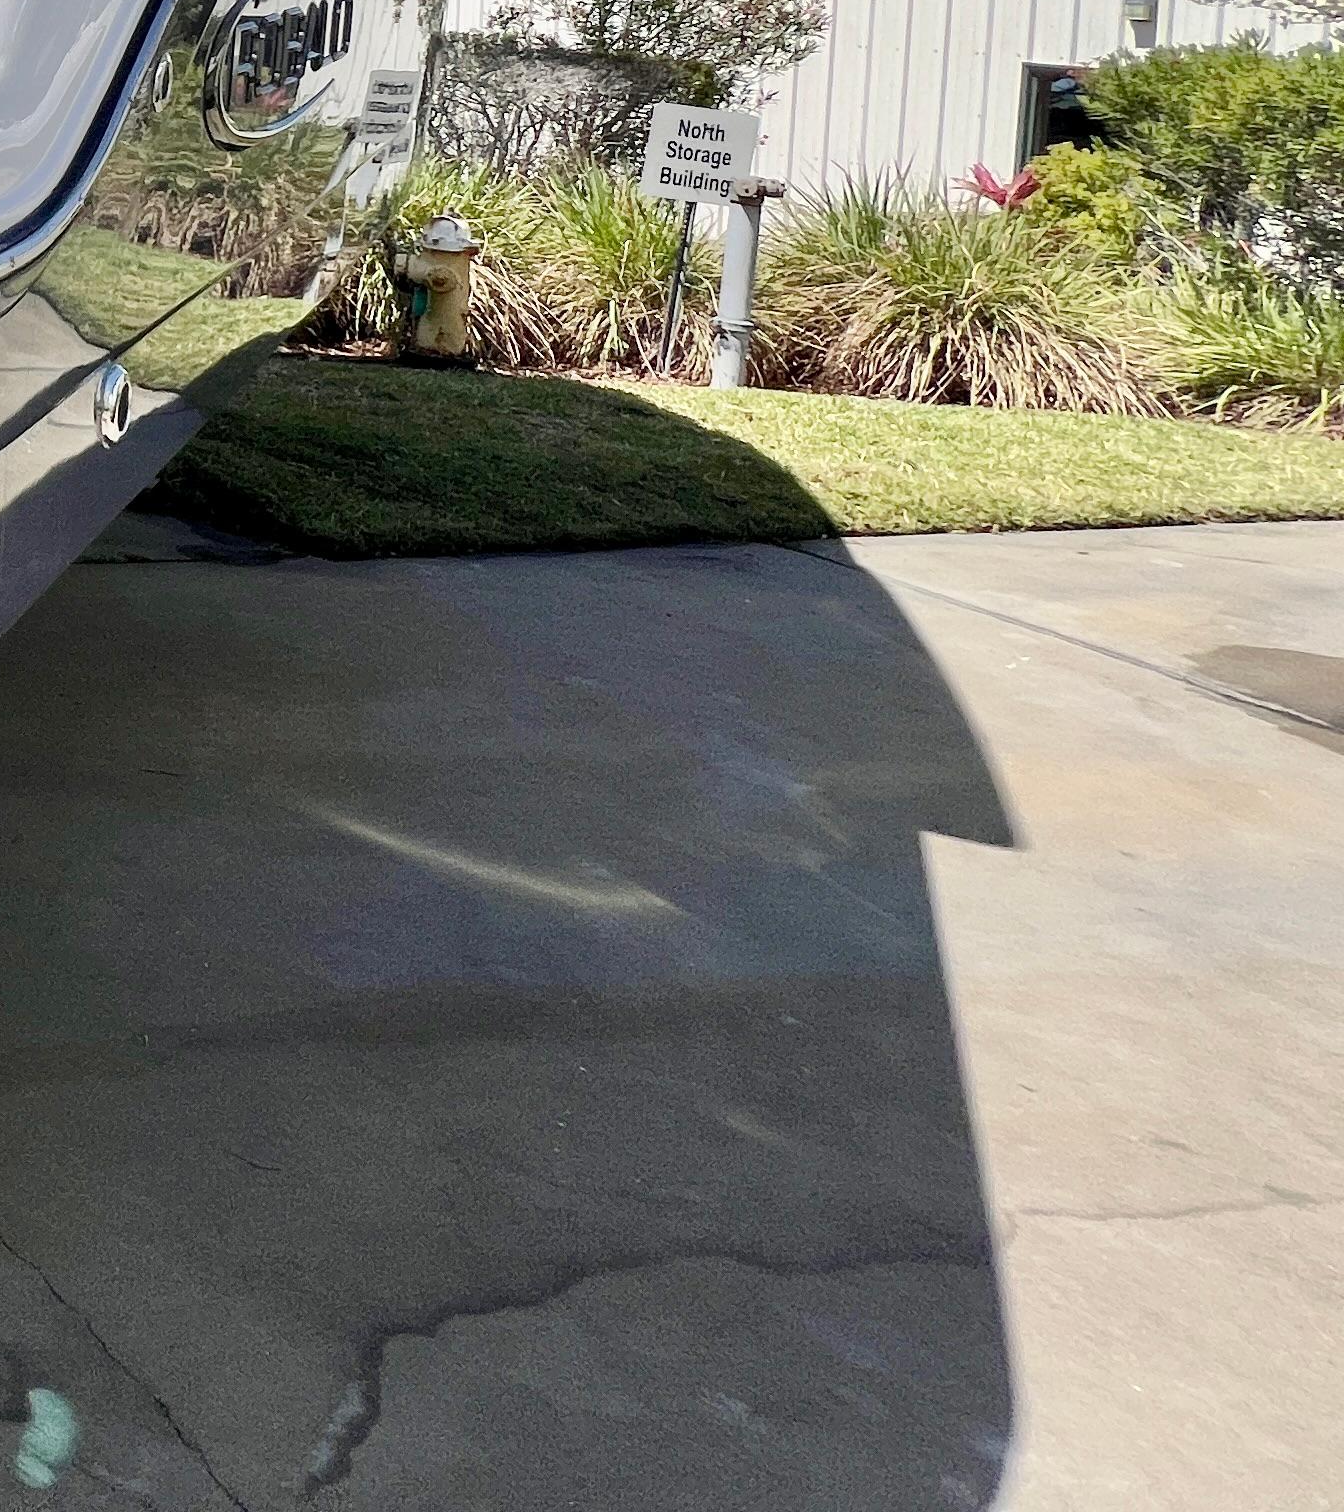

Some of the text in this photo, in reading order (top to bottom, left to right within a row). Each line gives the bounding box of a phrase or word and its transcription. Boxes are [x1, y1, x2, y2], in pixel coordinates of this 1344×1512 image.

[677, 119, 725, 142] North
[666, 140, 732, 169] Storage
[659, 166, 730, 198] Building
